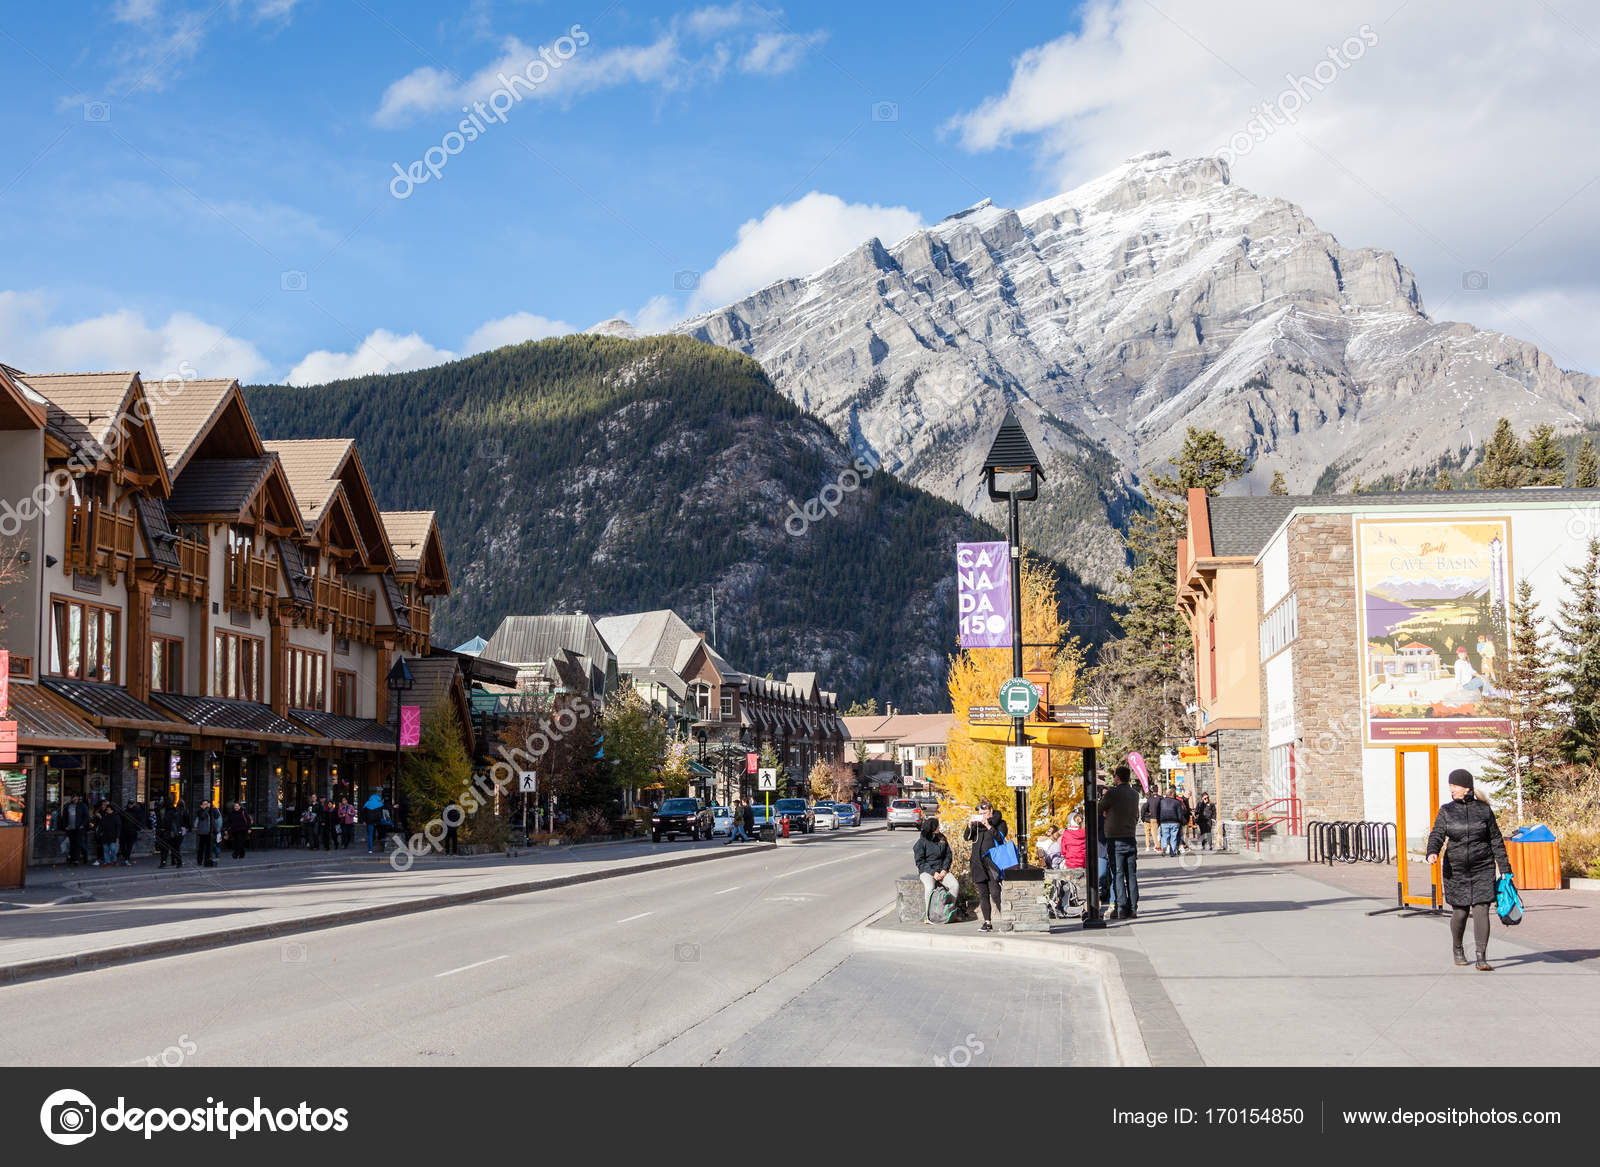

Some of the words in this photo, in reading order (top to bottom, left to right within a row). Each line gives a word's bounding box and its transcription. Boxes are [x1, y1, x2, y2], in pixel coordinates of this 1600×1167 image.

[957, 548, 993, 568] CA
[958, 570, 994, 590] NA
[959, 592, 995, 613] DA
[960, 615, 1006, 635] 150
